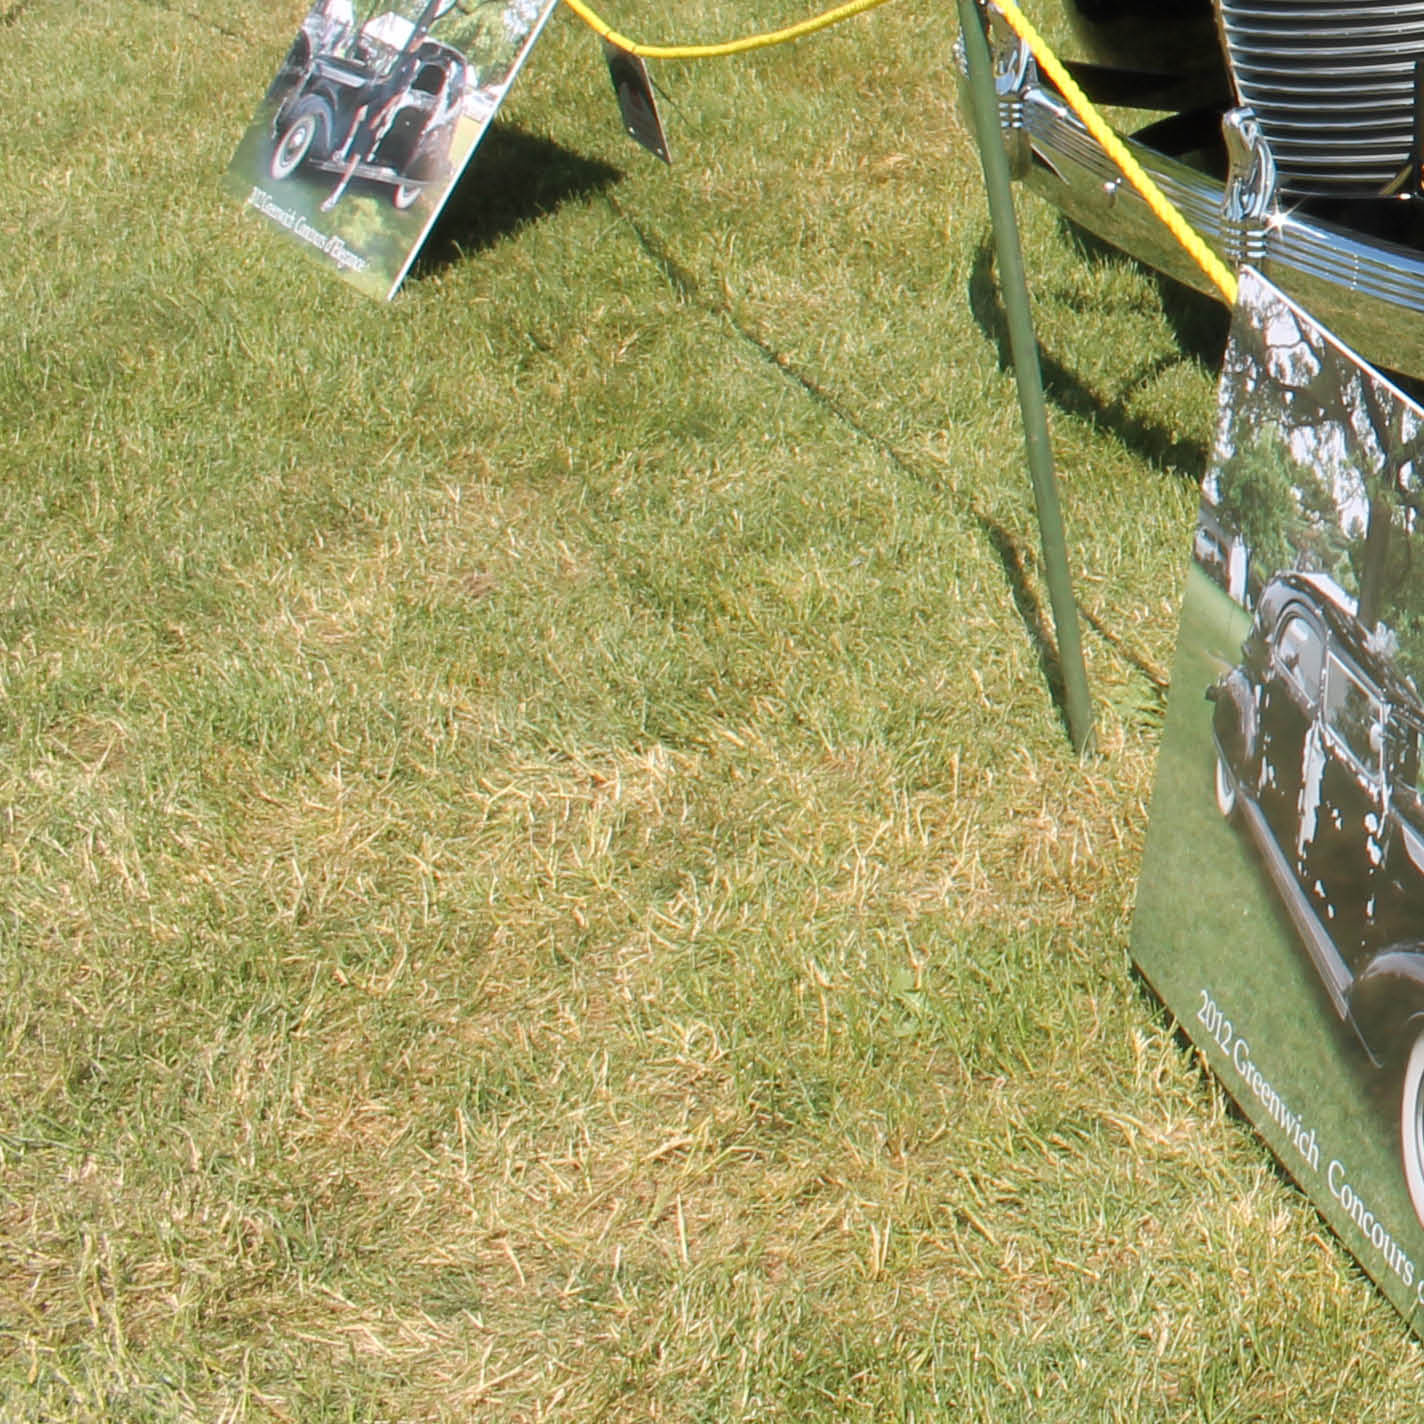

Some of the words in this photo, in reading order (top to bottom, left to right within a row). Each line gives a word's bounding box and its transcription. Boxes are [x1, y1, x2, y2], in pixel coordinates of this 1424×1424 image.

[1197, 990, 1232, 1056] 2012
[1233, 1039, 1320, 1173] Greenwich
[1328, 1160, 1414, 1286] Concours
